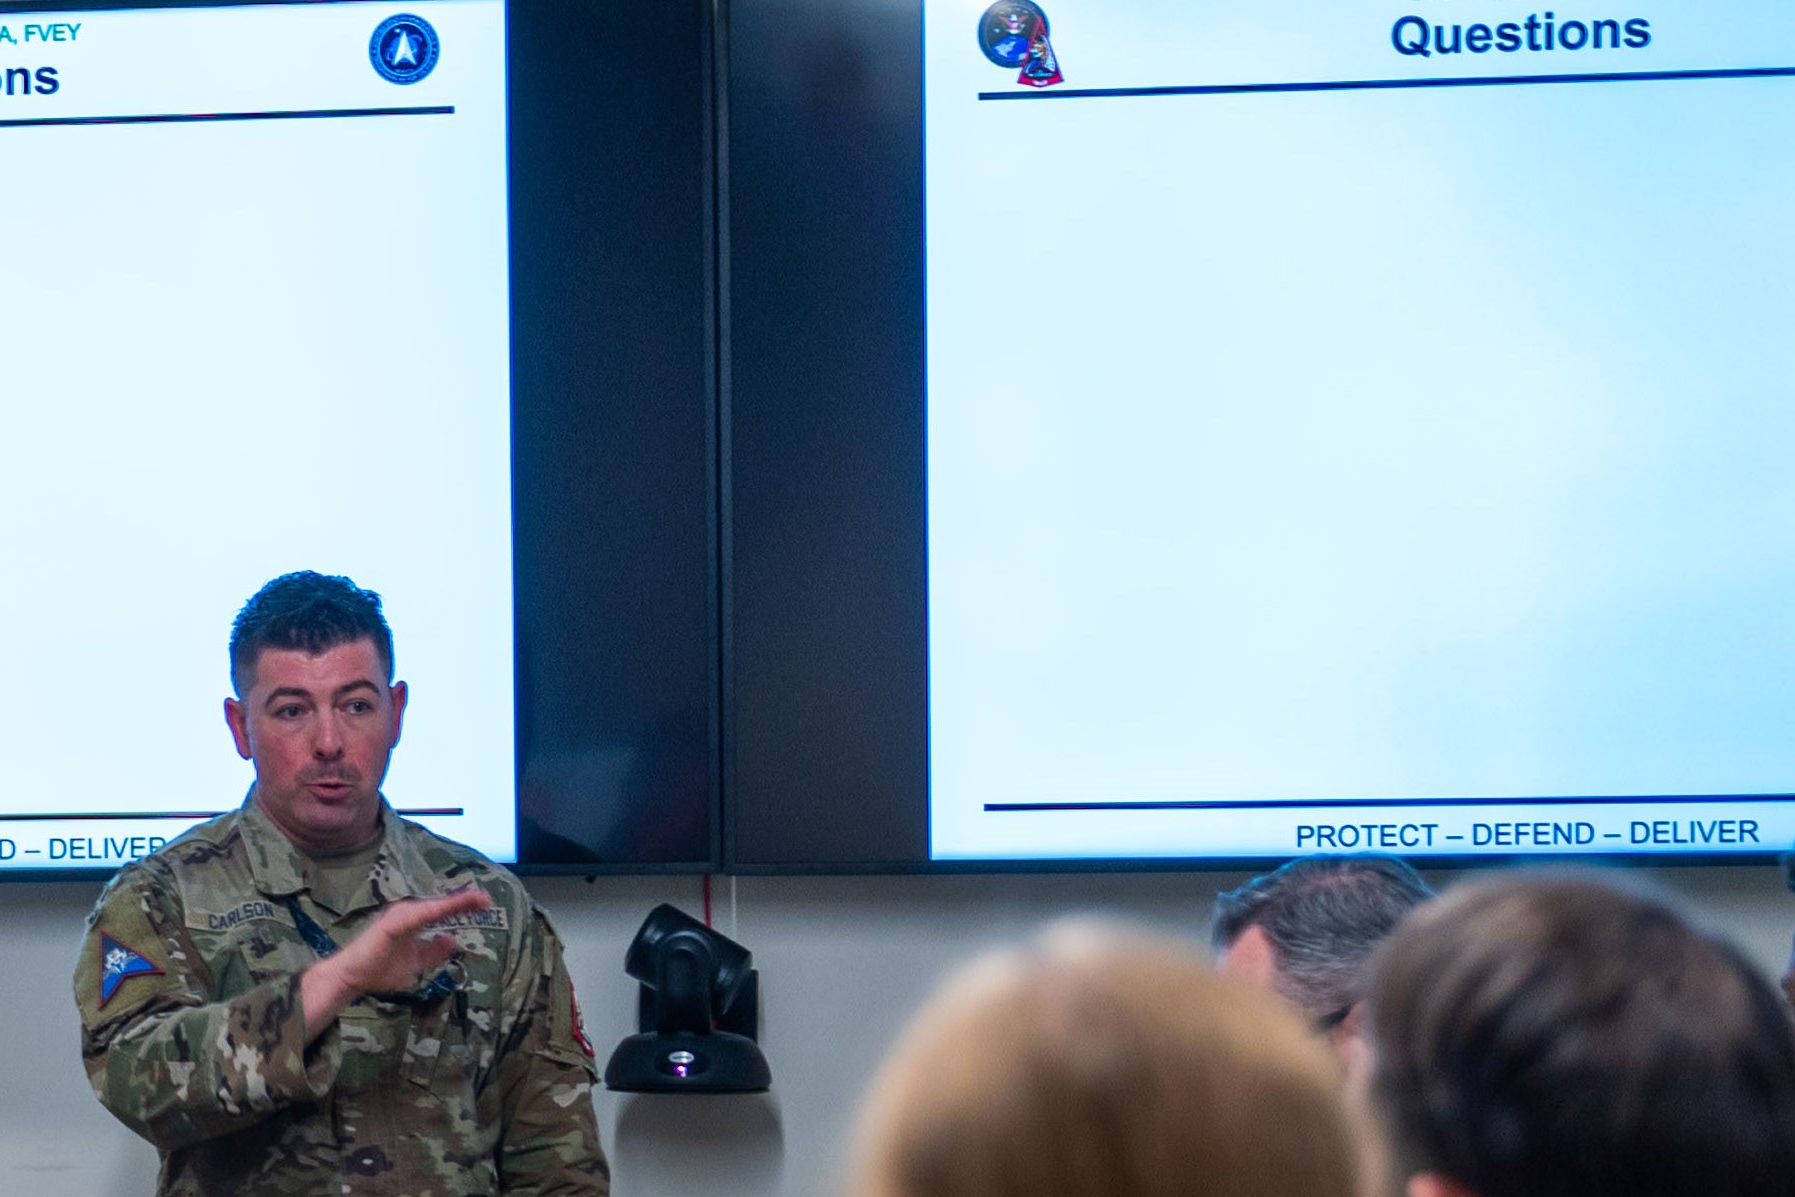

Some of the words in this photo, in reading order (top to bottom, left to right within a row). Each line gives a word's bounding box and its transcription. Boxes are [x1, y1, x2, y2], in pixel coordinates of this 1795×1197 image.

[24, 23, 82, 42] FVEY
[1391, 11, 1651, 57] Questions
[1296, 823, 1439, 848] PROTECT
[1472, 822, 1595, 846] DEFEND
[1630, 820, 1760, 844] DELIVER
[208, 902, 274, 929] CARLSON
